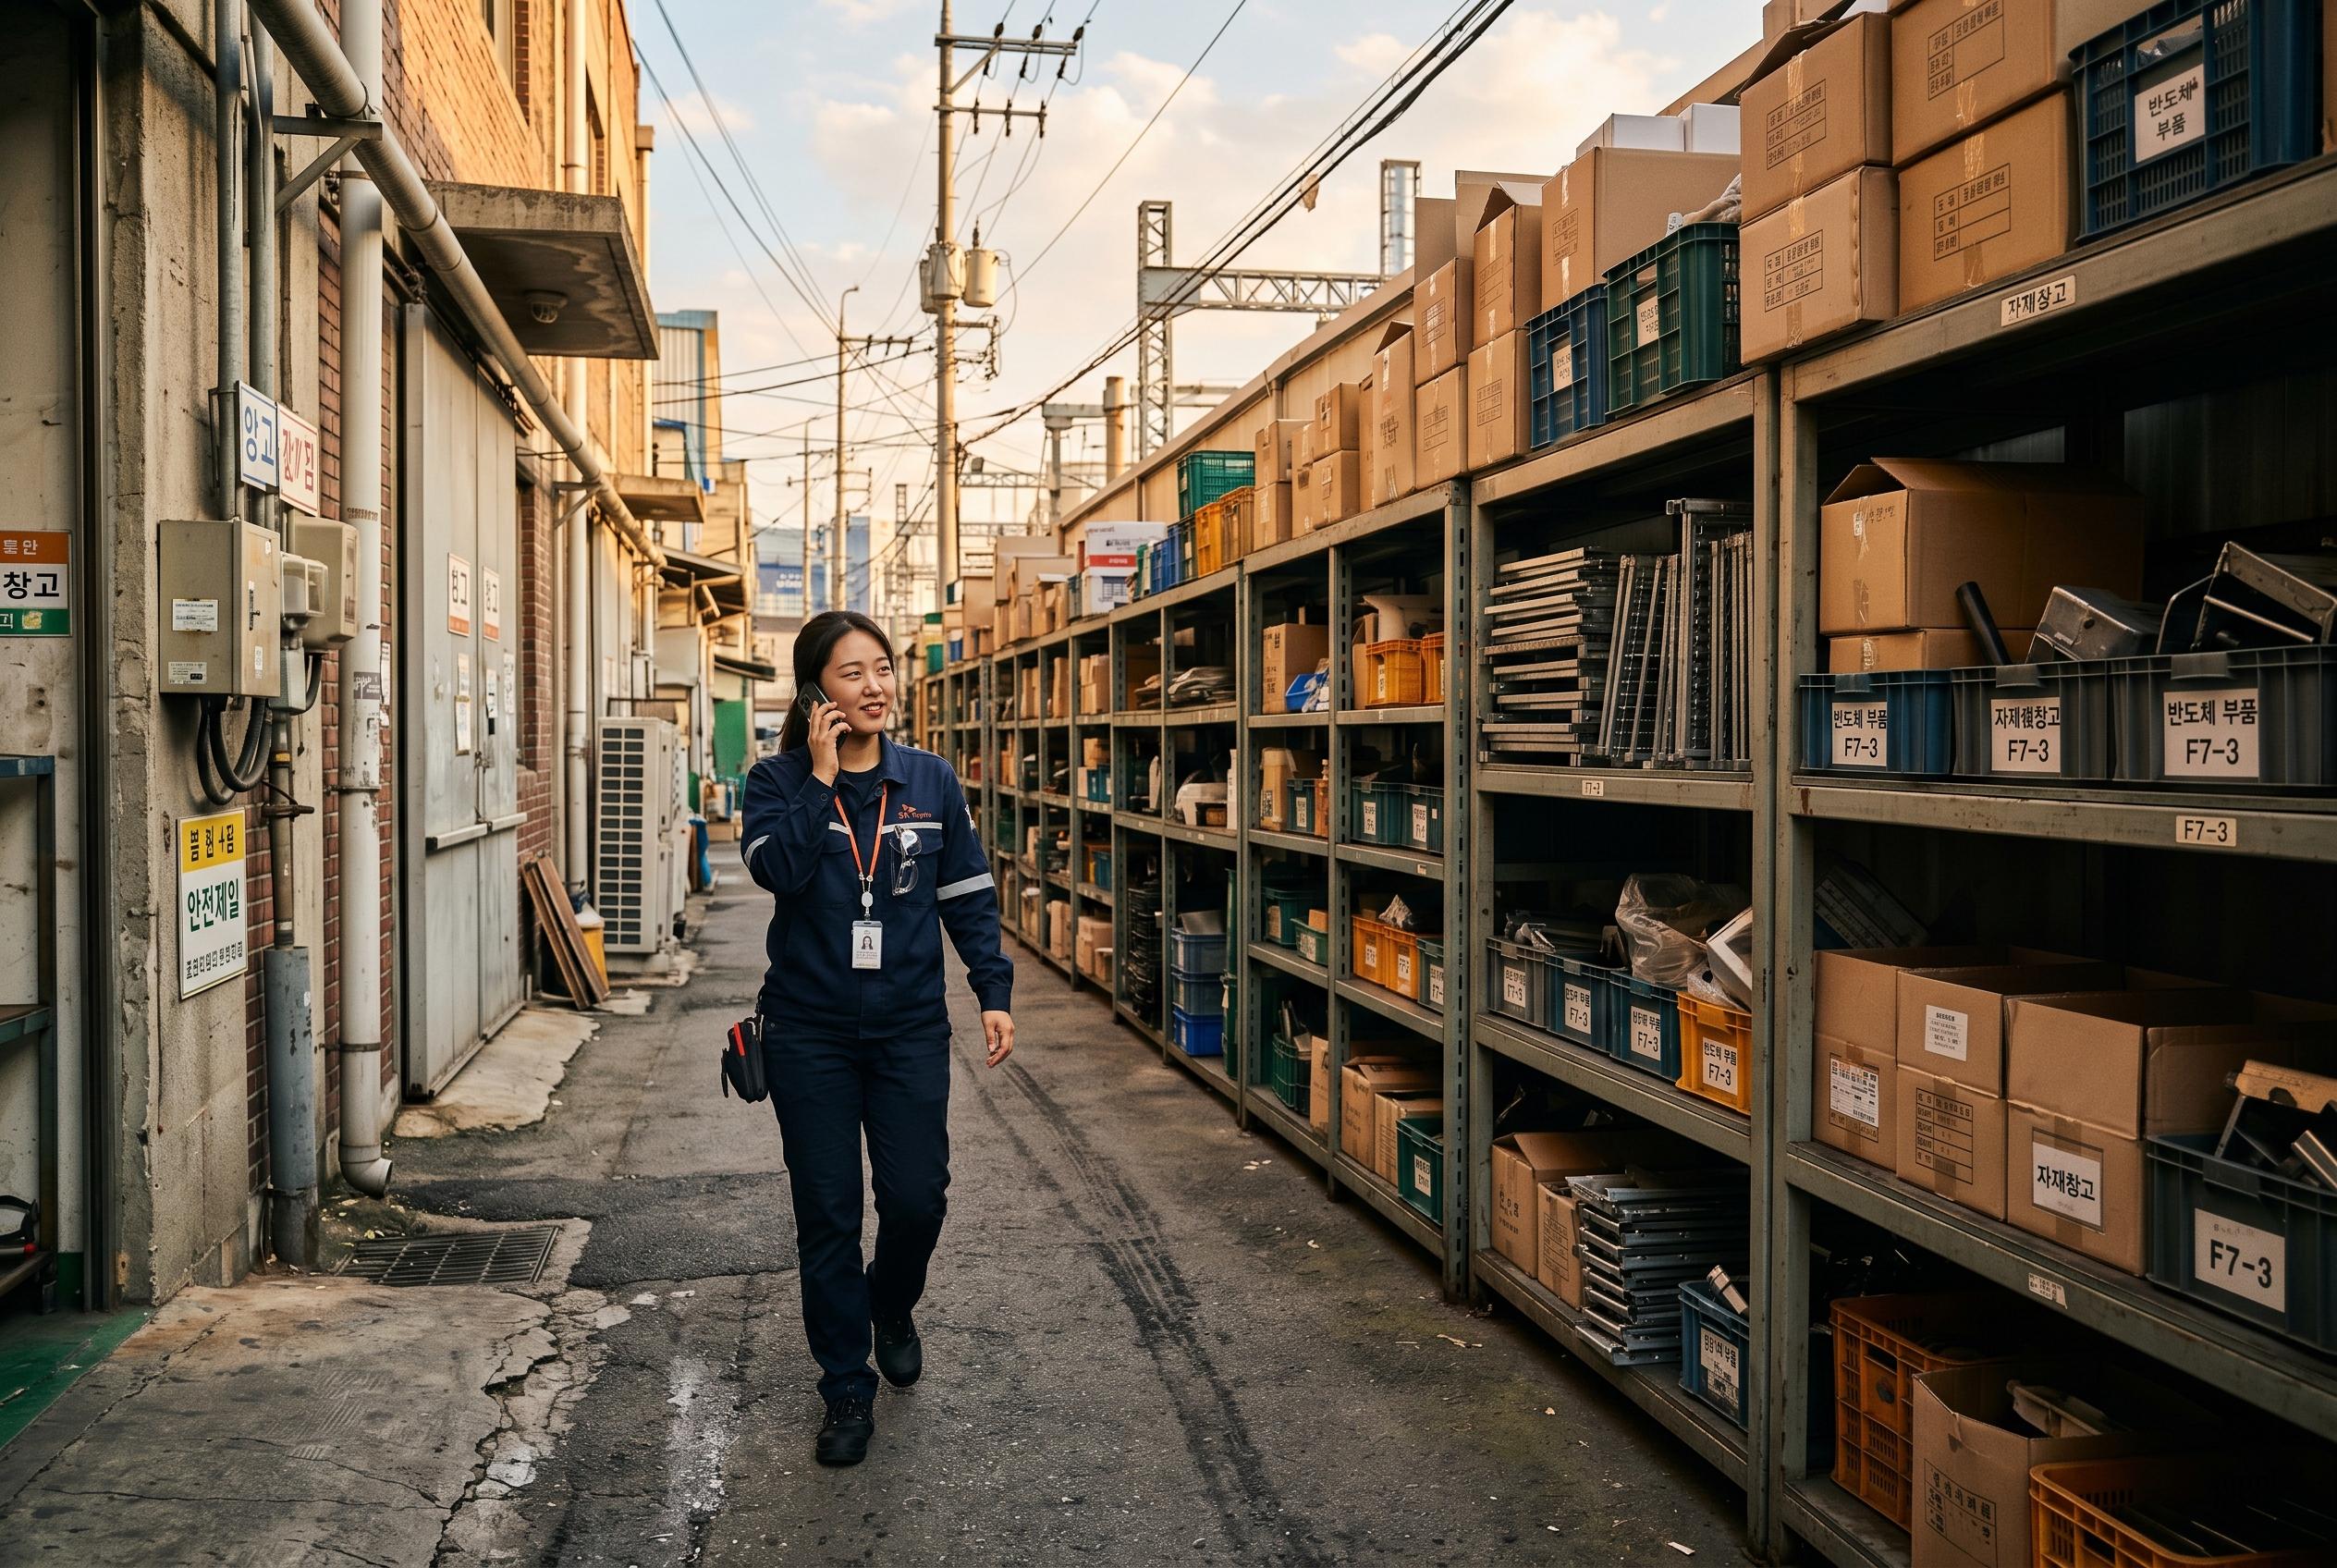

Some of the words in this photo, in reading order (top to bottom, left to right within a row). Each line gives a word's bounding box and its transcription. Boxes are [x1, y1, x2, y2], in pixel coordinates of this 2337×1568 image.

[3, 570, 60, 600] 창고
[2168, 699, 2216, 727] 반도체
[2222, 698, 2257, 726] 부품
[1844, 737, 1878, 758] F7-3
[2008, 739, 2049, 763] F7-3
[2186, 738, 2239, 766] F7-3
[2184, 819, 2228, 843] F7-3
[187, 878, 239, 933] 안전제일
[1570, 1007, 1588, 1027] F7-3
[1637, 1031, 1658, 1052] F7-3
[1708, 1062, 1731, 1086] F7-3
[2037, 1165, 2096, 1202] 자재창고
[2210, 1238, 2272, 1289] F7-3
